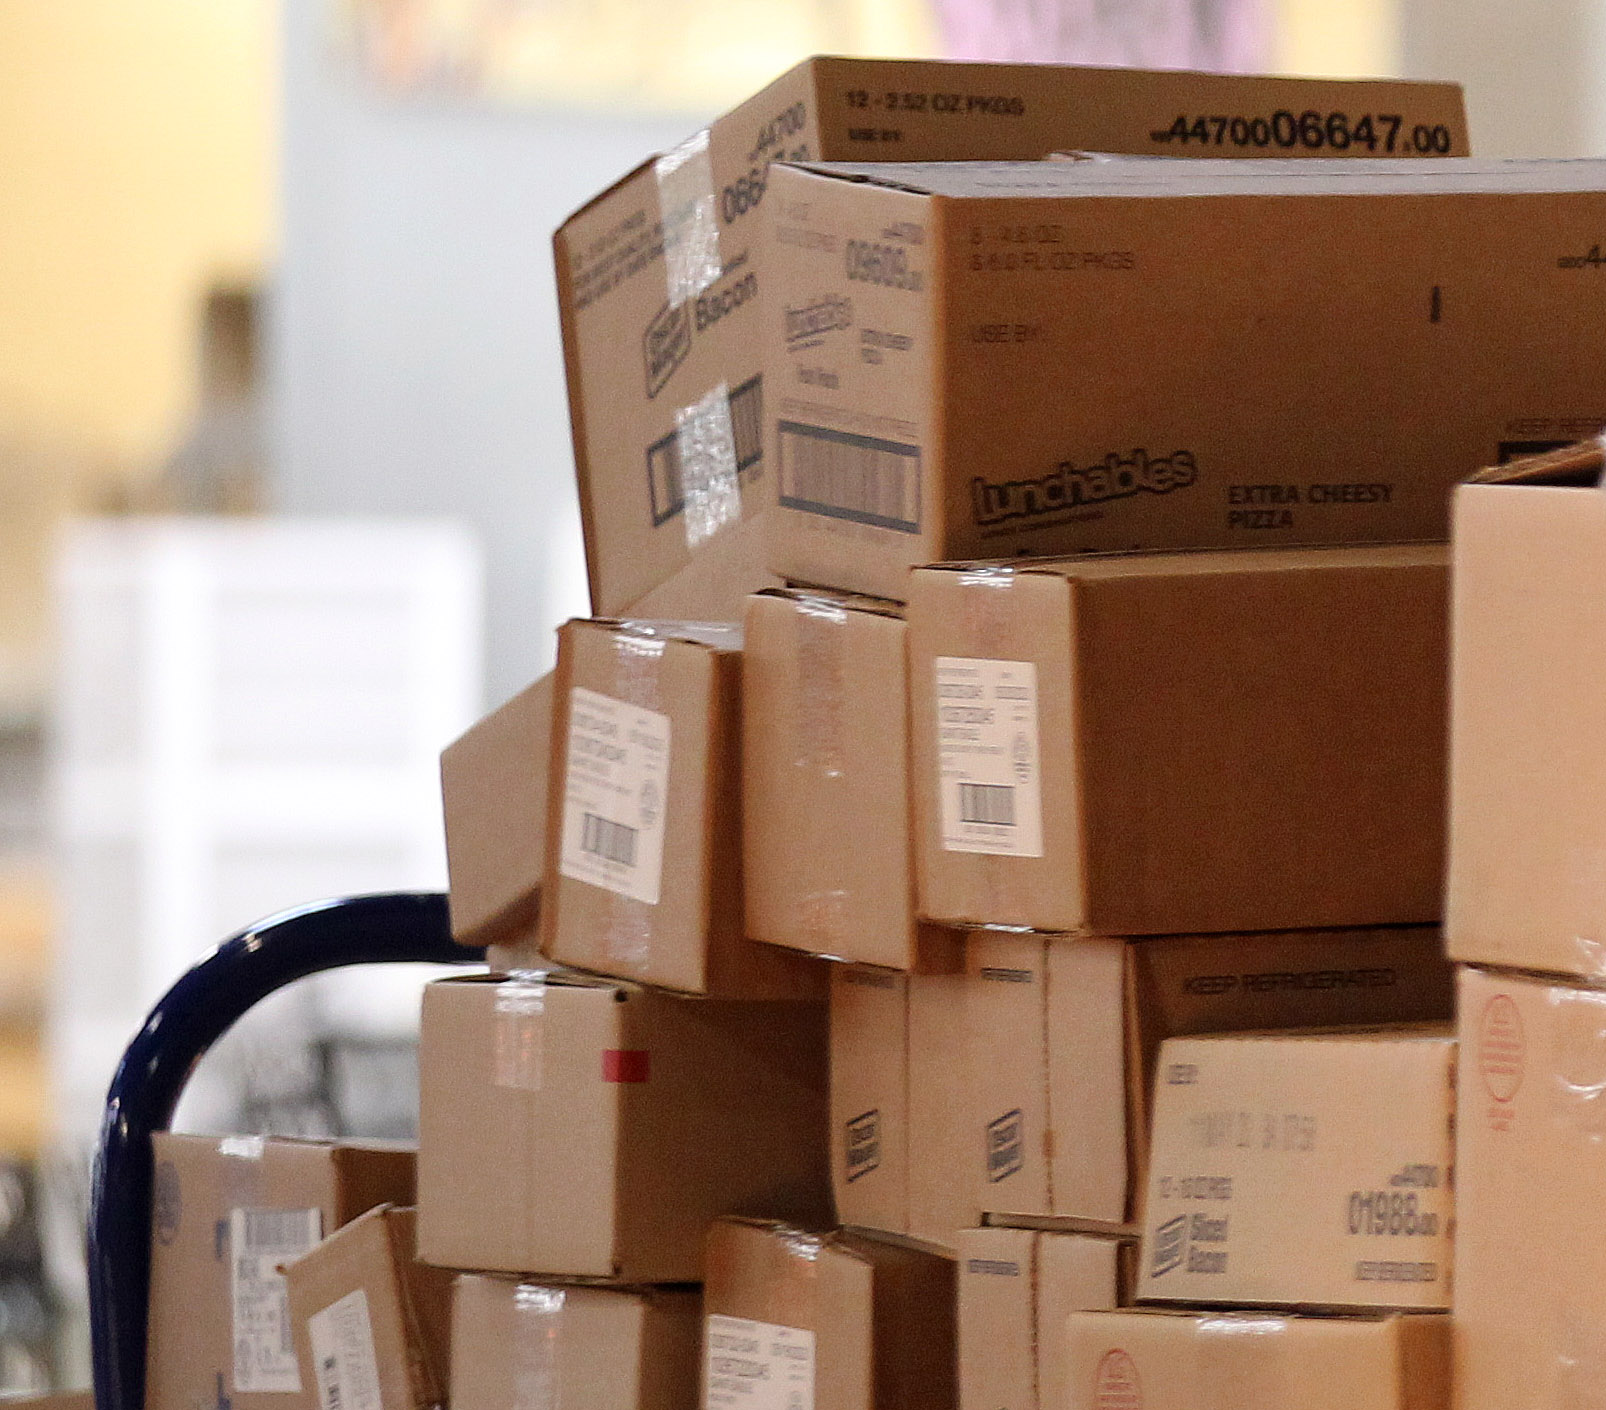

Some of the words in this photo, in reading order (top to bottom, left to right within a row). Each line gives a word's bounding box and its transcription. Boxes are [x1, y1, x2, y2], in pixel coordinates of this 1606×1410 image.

[1229, 484, 1299, 504] EXTRA
[1307, 484, 1394, 504] CHEESY
[1229, 510, 1293, 530] PIZZA
[1183, 976, 1238, 995] KEEP
